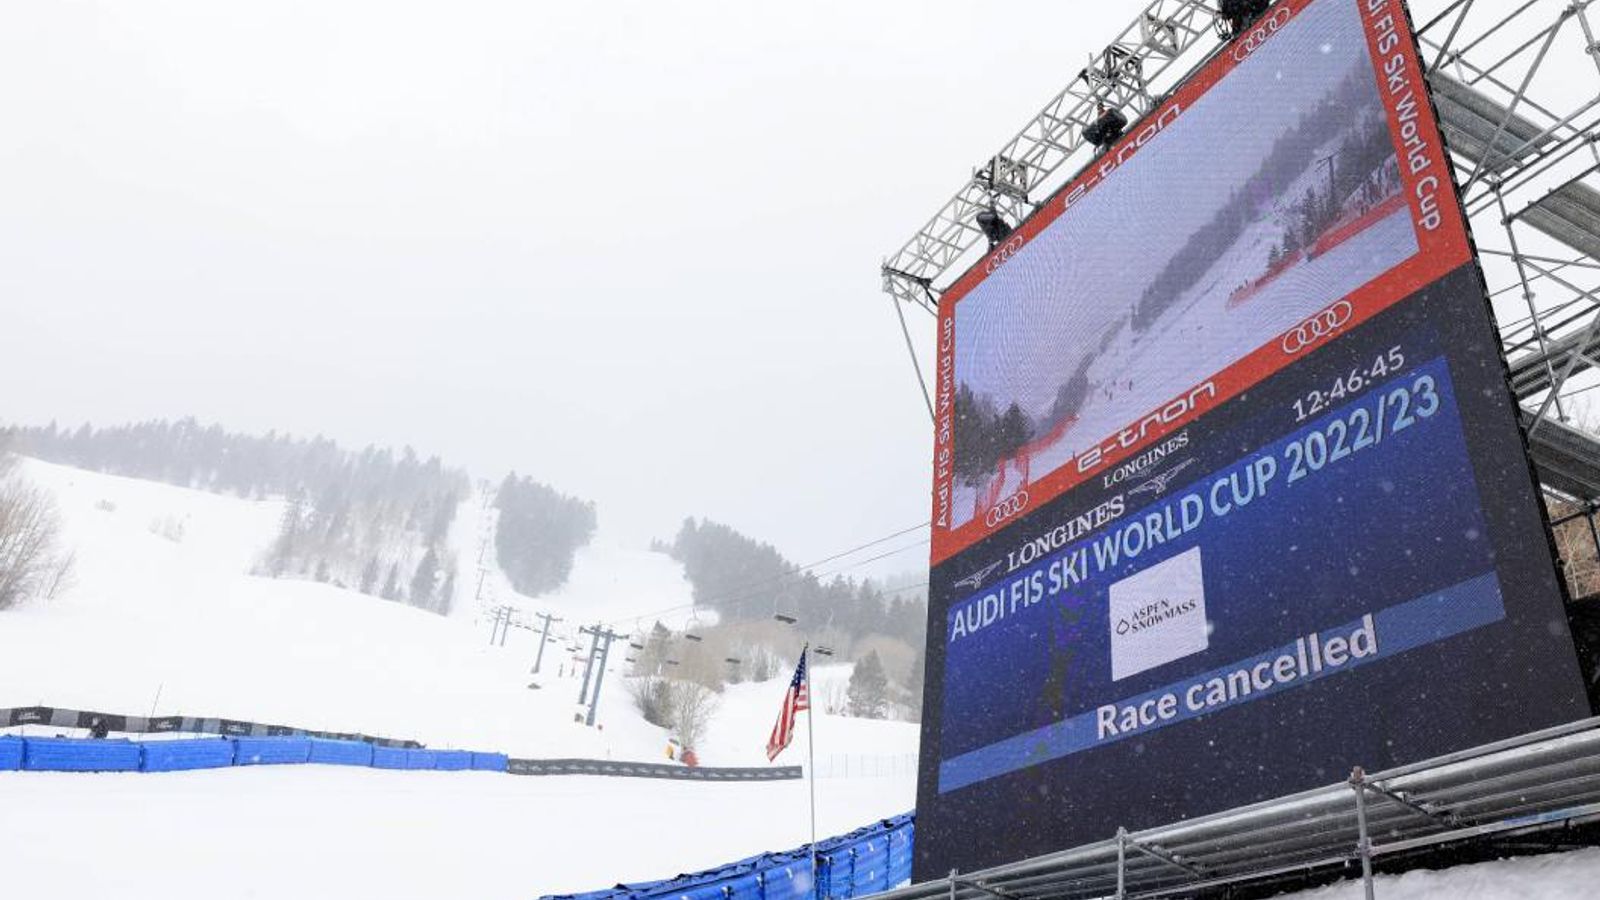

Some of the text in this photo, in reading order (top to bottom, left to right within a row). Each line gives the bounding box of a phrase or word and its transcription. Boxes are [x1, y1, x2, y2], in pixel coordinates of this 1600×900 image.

[1374, 14, 1399, 54] FIS
[1385, 53, 1410, 95] Ski
[1065, 103, 1180, 208] e-tron
[1396, 90, 1432, 175] World
[1416, 175, 1441, 231] Cup
[937, 317, 952, 527] Audi FIS Ski World Cup
[1291, 345, 1405, 422] 12:46:45
[1077, 381, 1215, 473] e-tron
[1103, 432, 1189, 489] LONGINES
[951, 374, 1440, 642] AUDI FIS SKI WORLD CUP 2022/23
[1007, 495, 1125, 572] LONGINES
[1131, 599, 1197, 634] SNOWMASS
[1132, 598, 1169, 622] ASPEN
[1097, 613, 1379, 741] Race cancelled
